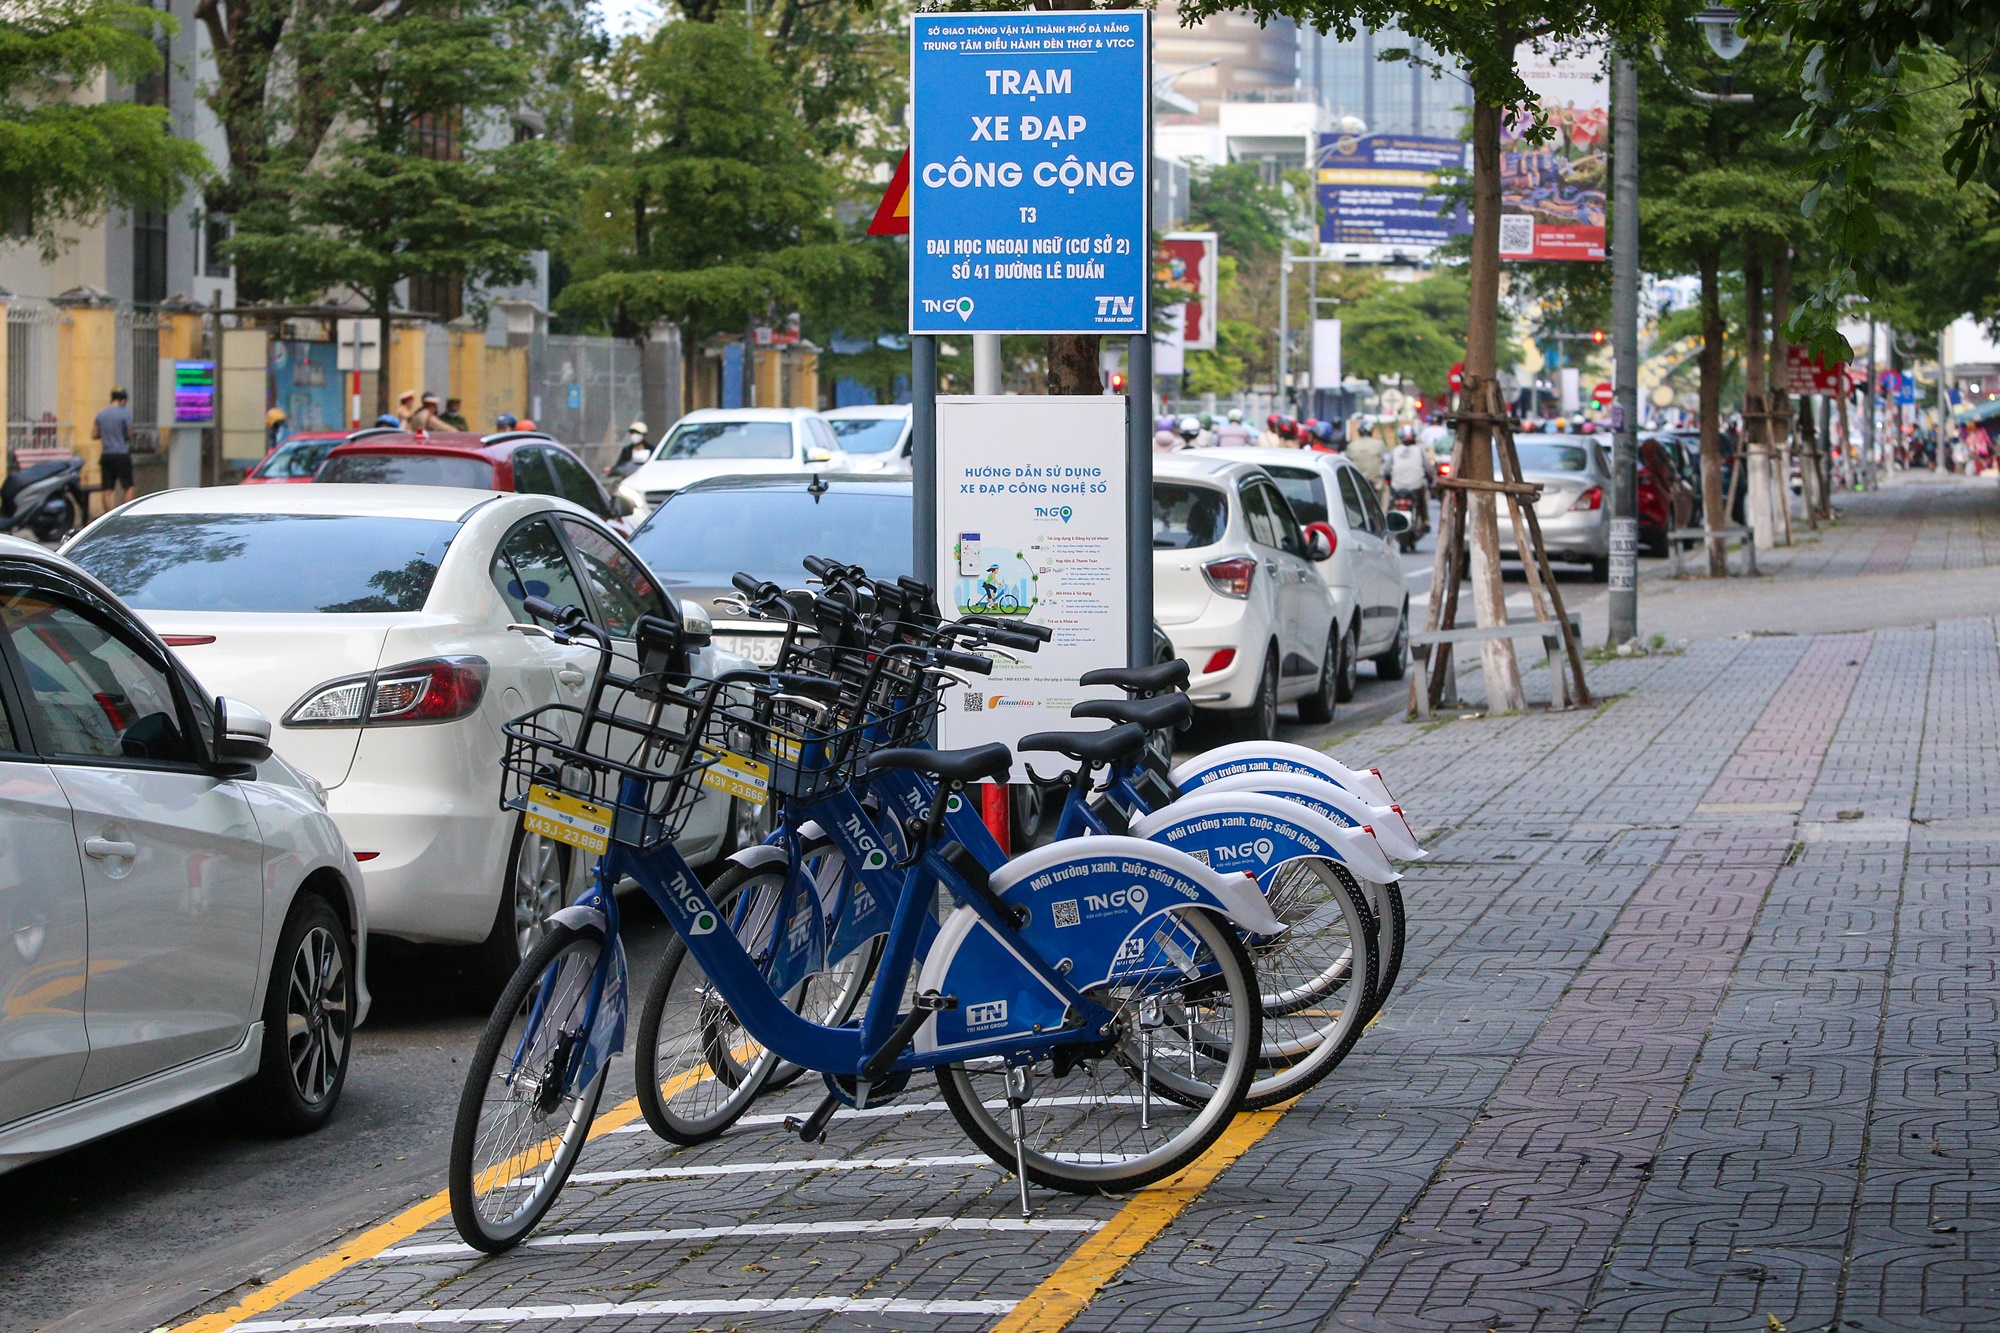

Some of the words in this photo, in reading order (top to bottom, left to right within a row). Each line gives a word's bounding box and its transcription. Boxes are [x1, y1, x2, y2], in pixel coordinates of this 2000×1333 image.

[928, 25, 940, 36] SỞ
[942, 27, 965, 35] GIAO
[967, 25, 998, 35] THÔNG
[1000, 25, 1018, 36] VẬN
[1021, 23, 1033, 34] TẢI
[1037, 25, 1065, 34] THÀNH
[1068, 23, 1086, 33] PHỐ
[1089, 24, 1101, 33] ĐÀ
[1104, 22, 1130, 33] NẴNG
[923, 42, 957, 51] TRUNG
[960, 39, 982, 50] TÂM
[985, 37, 1007, 50] ĐIỀU
[1011, 38, 1040, 49] HÀNH
[1043, 39, 1063, 49] ĐÈN
[1067, 40, 1092, 49] THGT
[1096, 40, 1103, 48] &
[1106, 39, 1135, 48] VTCC
[986, 69, 1072, 102] TRẠM
[970, 116, 1009, 141] XE
[1020, 116, 1086, 147] ĐẠP
[922, 155, 1023, 188] CÔNG
[1033, 154, 1134, 194] CỘNG
[1019, 207, 1037, 223] T3
[927, 239, 950, 257] ĐẠI
[954, 239, 981, 257] HỌC
[986, 239, 1028, 257] NGOẠI
[1033, 237, 1063, 254] NGỮ
[1066, 239, 1090, 256] (CƠ
[1094, 234, 1112, 254] SỞ
[1116, 239, 1130, 255] 2)
[952, 259, 971, 279] SỐ
[974, 264, 989, 279] 41
[995, 261, 1042, 279] ĐƯỜNG
[1047, 261, 1062, 279] LÊ
[1067, 258, 1104, 279] DUẨN
[1094, 296, 1134, 315] TN
[966, 466, 1011, 477] HƯỚNG
[1016, 464, 1042, 477] DẪN
[1047, 465, 1061, 477] SỬ
[1066, 468, 1101, 479] DỤNG
[960, 484, 975, 493] XE
[979, 484, 1004, 496] ĐẠP
[1009, 482, 1047, 493] CÔNG
[1052, 482, 1086, 495] NGHỆ
[1090, 480, 1107, 492] SỐ
[730, 637, 782, 661] 155.3
[1201, 774, 1218, 784] Môi
[1218, 764, 1247, 778] trường
[1248, 762, 1270, 771] xanh.
[1166, 828, 1187, 842] Môi
[1187, 819, 1220, 835] trường
[1222, 816, 1247, 827] xanh.
[1249, 817, 1273, 831] Cuộc
[1273, 823, 1299, 840] sống
[1297, 832, 1321, 853] khỏe
[1029, 877, 1053, 892] Môi
[1053, 865, 1089, 883] trường
[1092, 862, 1119, 873] xanh.
[1122, 862, 1147, 877] Cuộc
[1149, 868, 1175, 888] sống
[1173, 877, 1200, 901] khỏe
[971, 1004, 1002, 1022] TN
